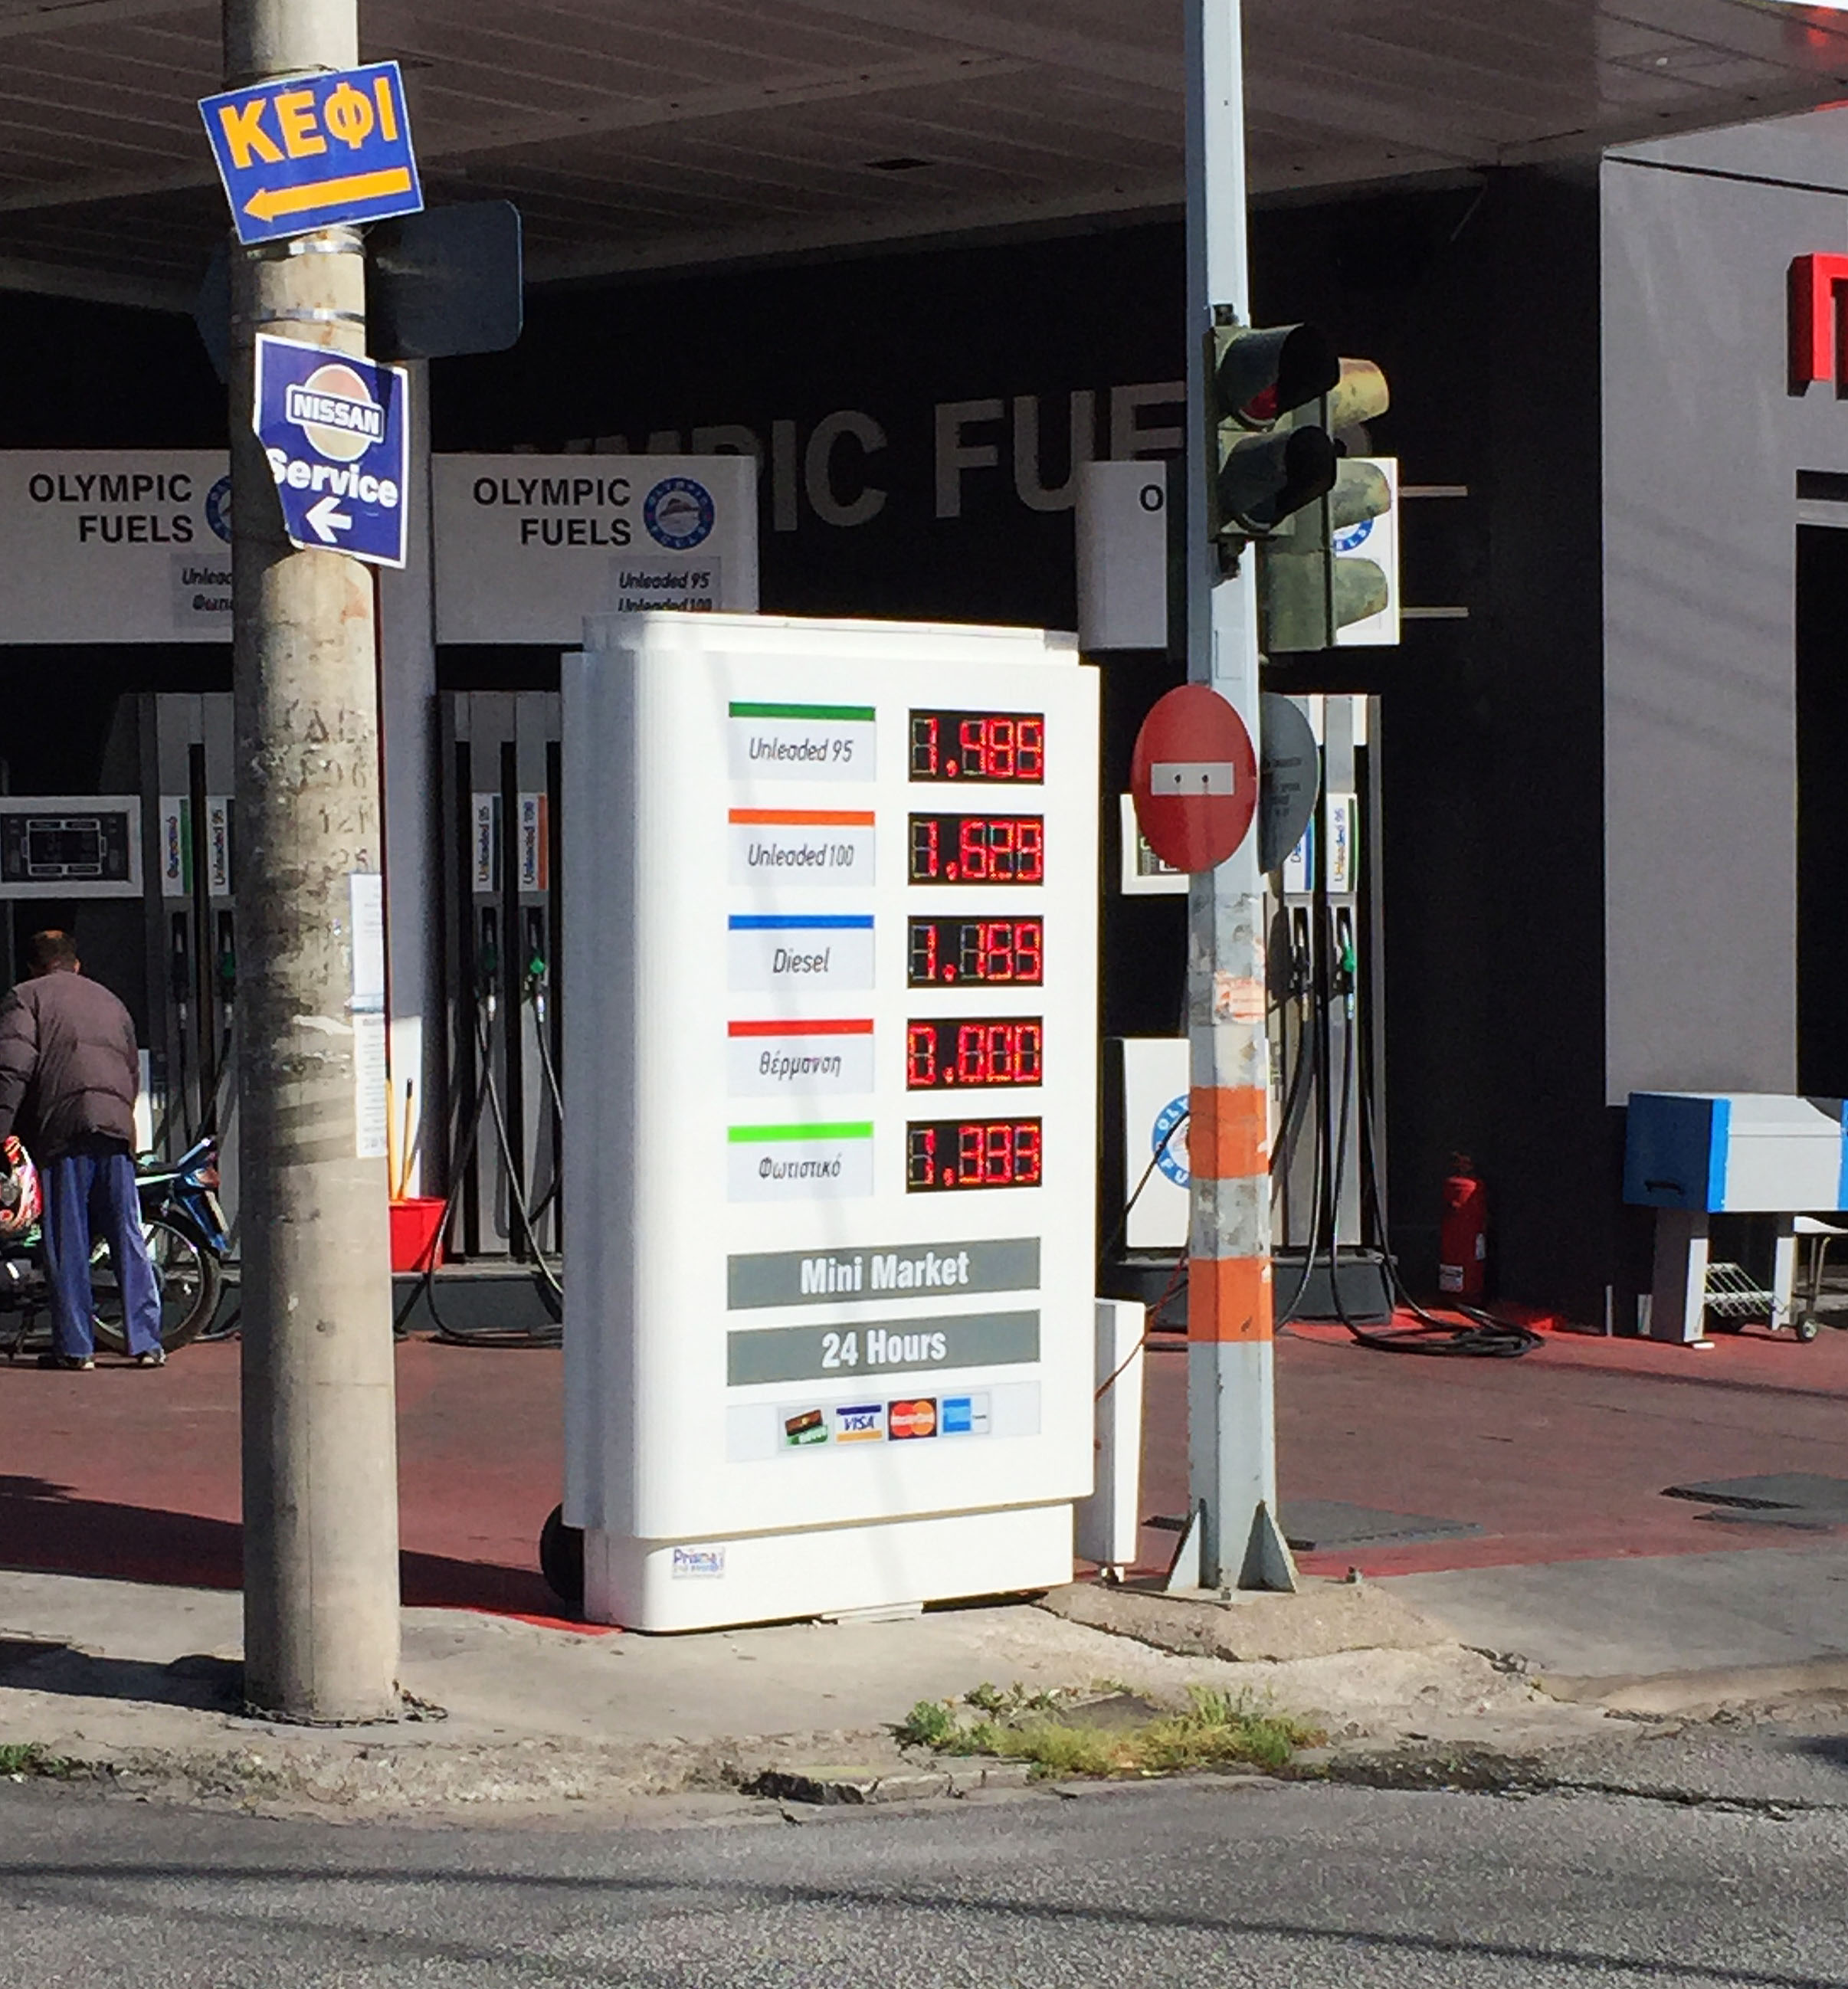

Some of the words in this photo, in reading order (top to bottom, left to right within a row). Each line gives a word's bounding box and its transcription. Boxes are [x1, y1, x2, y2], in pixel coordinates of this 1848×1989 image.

[219, 77, 398, 169] ΚΕΦΙ
[293, 392, 381, 435] NISSAN
[29, 473, 192, 503] OLYMPIC
[267, 448, 398, 509] Service
[473, 478, 631, 506] OLYMPIC
[79, 516, 193, 542] FUELS
[520, 519, 631, 546] FUELS
[619, 571, 688, 589] Unleaded
[691, 571, 711, 589] 95
[749, 738, 828, 762] Unleaded
[832, 740, 854, 762] 95
[748, 844, 827, 867] Unleaded
[829, 845, 854, 867] 100
[772, 947, 830, 974] Diesel
[909, 1024, 1040, 1084] 0.000
[759, 1153, 841, 1180] Φωτιστικό
[801, 1255, 863, 1295] Mini
[871, 1251, 969, 1289] Market
[822, 1332, 858, 1368] 24
[867, 1329, 947, 1365] Hours
[844, 1415, 875, 1430] VISA
